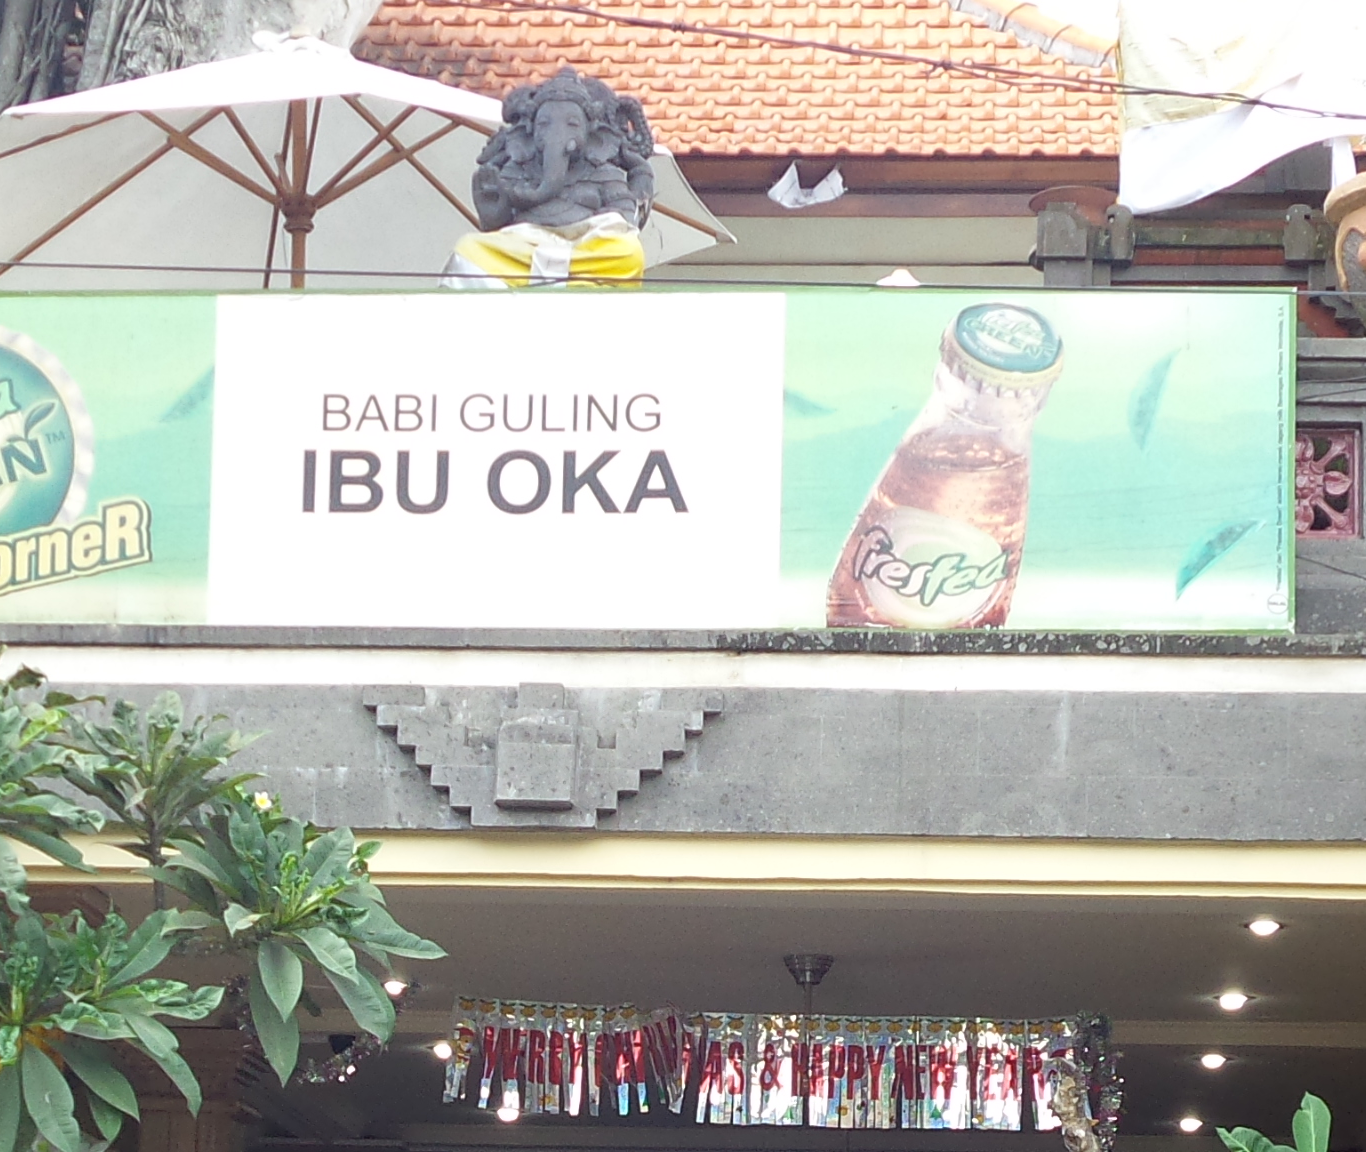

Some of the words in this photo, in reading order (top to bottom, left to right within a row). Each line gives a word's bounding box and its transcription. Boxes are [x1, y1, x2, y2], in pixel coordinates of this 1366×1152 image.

[322, 393, 437, 432] BABI
[459, 393, 662, 432] GULING
[302, 449, 450, 514] IBU
[487, 449, 689, 514] OKA
[853, 526, 1010, 606] frestea
